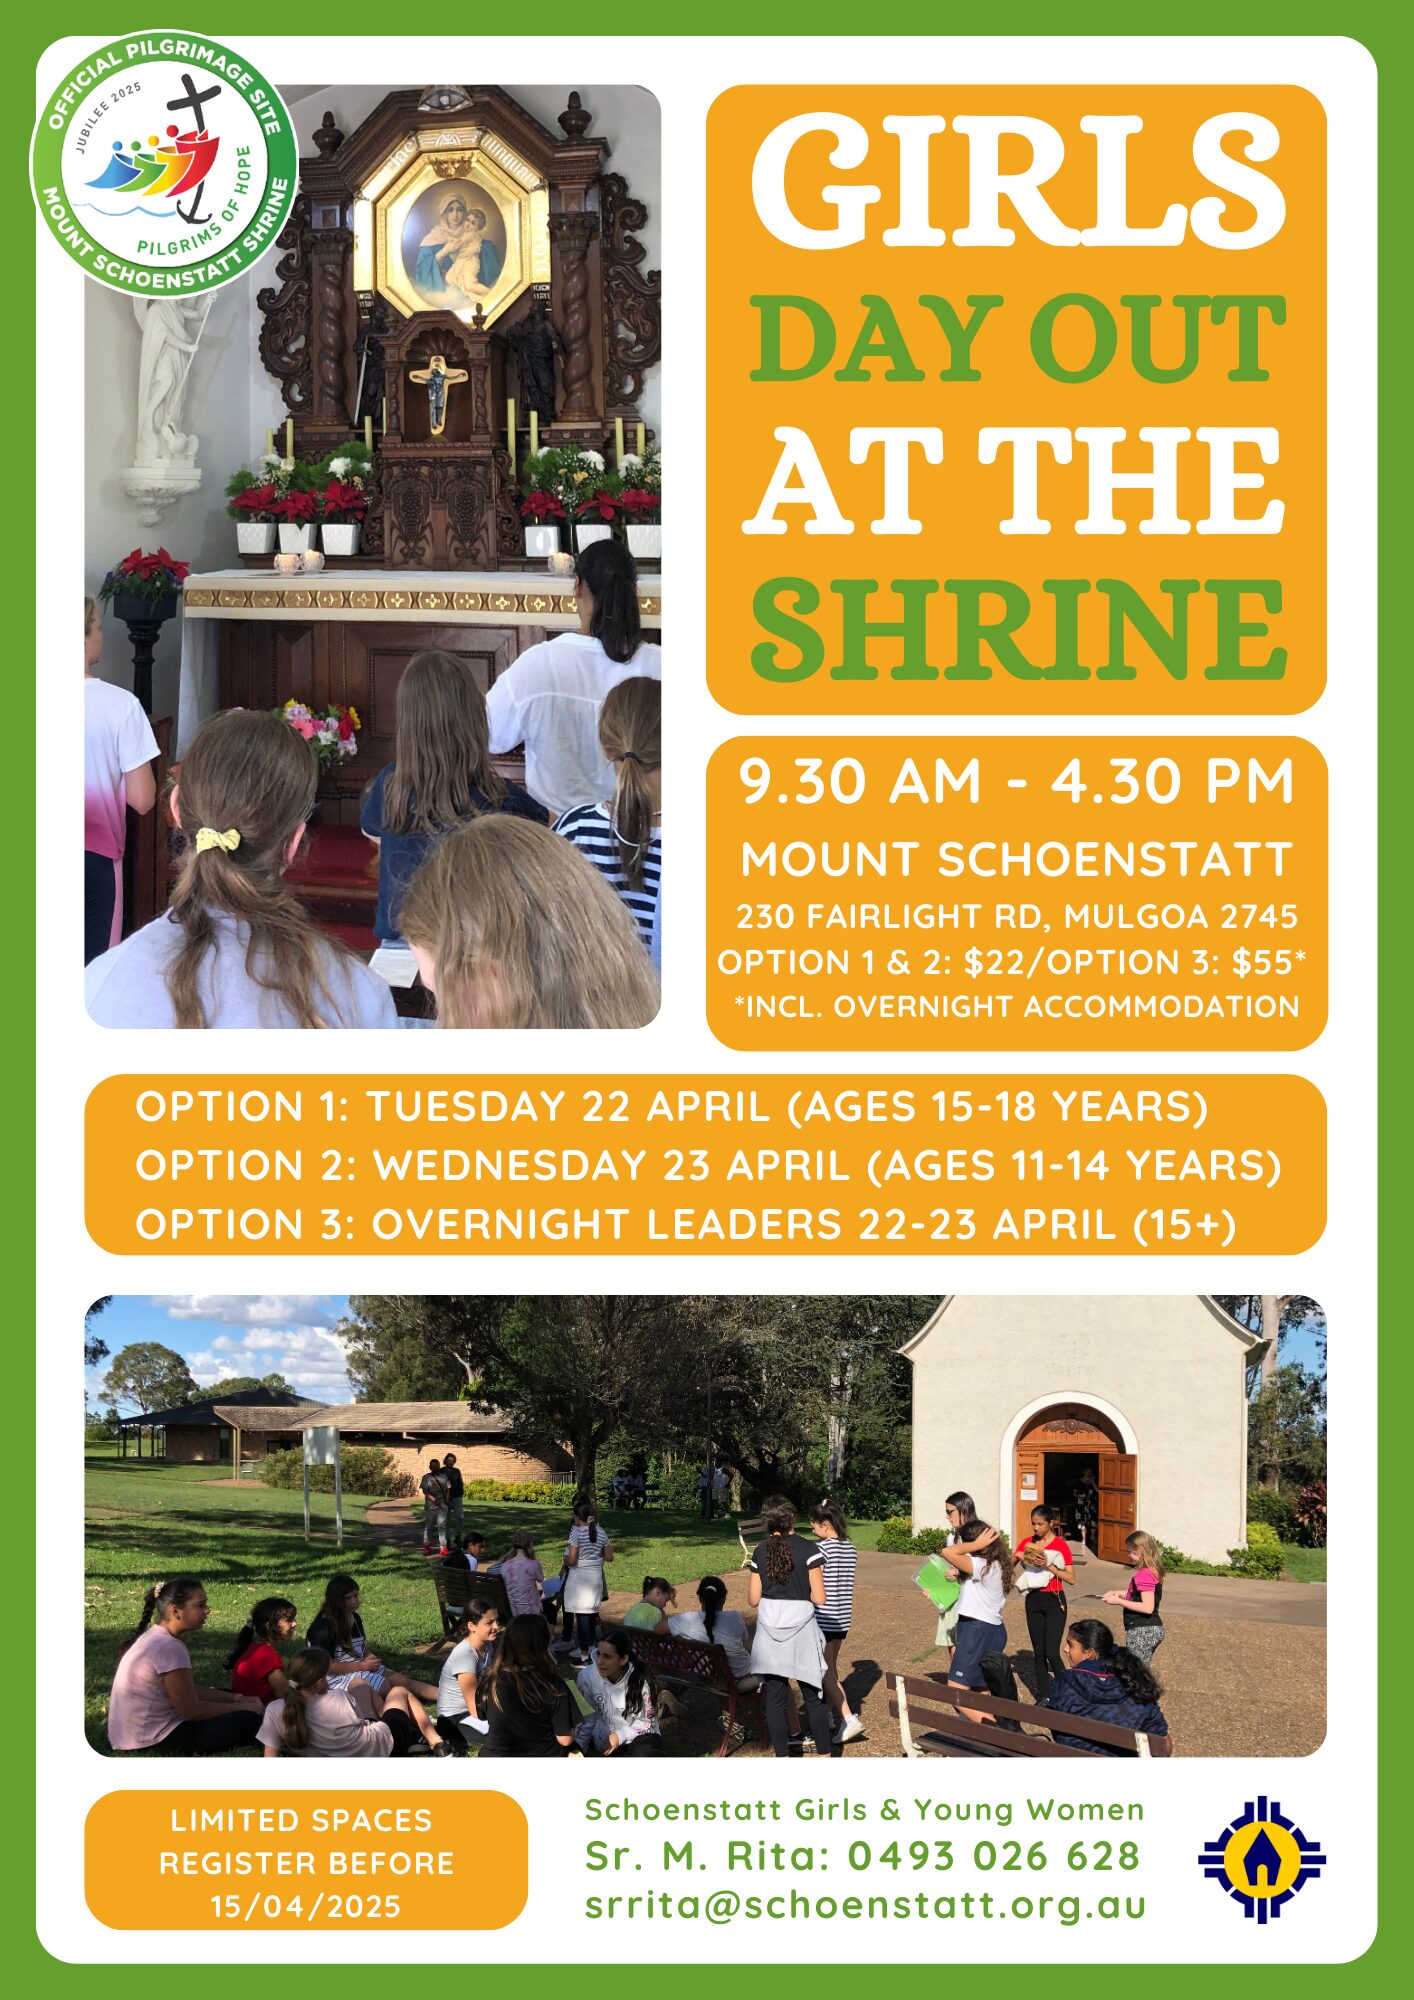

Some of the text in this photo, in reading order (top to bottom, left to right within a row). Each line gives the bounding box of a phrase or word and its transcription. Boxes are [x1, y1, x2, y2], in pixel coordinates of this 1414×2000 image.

[49, 39, 281, 136] OFFICIAL PILGRIMAGE SITE
[76, 82, 141, 154] JUBILEE 2025
[752, 112, 1286, 250] GIRLS
[137, 146, 251, 255] PILGRIMS OF HOPE
[43, 177, 287, 288] MOUNT SCHOENSTATT SHRINE
[749, 293, 1287, 384] DAY OUT
[742, 427, 1285, 534] AT THE
[751, 576, 1288, 683] SHRINE
[740, 758, 865, 804] 9.30
[890, 758, 979, 803] AM
[1052, 758, 1180, 804] 4.30
[1208, 758, 1292, 803] PM
[743, 842, 1292, 877] MOUNT SCHOENSTATT
[737, 904, 1297, 932] 230 FAIRLIGHT RD, MULGOA 2745
[718, 950, 848, 974] OPTION
[863, 950, 872, 974] 1
[888, 950, 910, 974] &
[924, 950, 950, 974] 2:
[965, 947, 1178, 978] $22/OPTION
[1193, 950, 1218, 974] 3:
[834, 996, 1013, 1017] OVERNIGHT
[1024, 996, 1298, 1017] ACCOMMODATION
[136, 1091, 1207, 1129] OPTION 1: TUESDAY 22 APRIL (AGES 15-18 YEARS)
[136, 1150, 1280, 1188] OPTION 2: WEDNESDAY 23 APRIL (AGES 11-14 YEARS)
[136, 1209, 1235, 1247] OPTION 3: OVERNIGHT LEADERS 22-23 APRIL (15+)
[172, 1809, 431, 1831] LIMITED SPACES
[586, 1798, 1142, 1826] Schoenstatt Girls & Young Women
[161, 1852, 453, 1874] REGISTER BEFORE
[587, 1841, 1138, 1870] Sr. M. Rita: 0493 026 628
[211, 1893, 400, 1921] 15/04/2025
[586, 1890, 1145, 1925] srrita@schoenstatt.org.au
